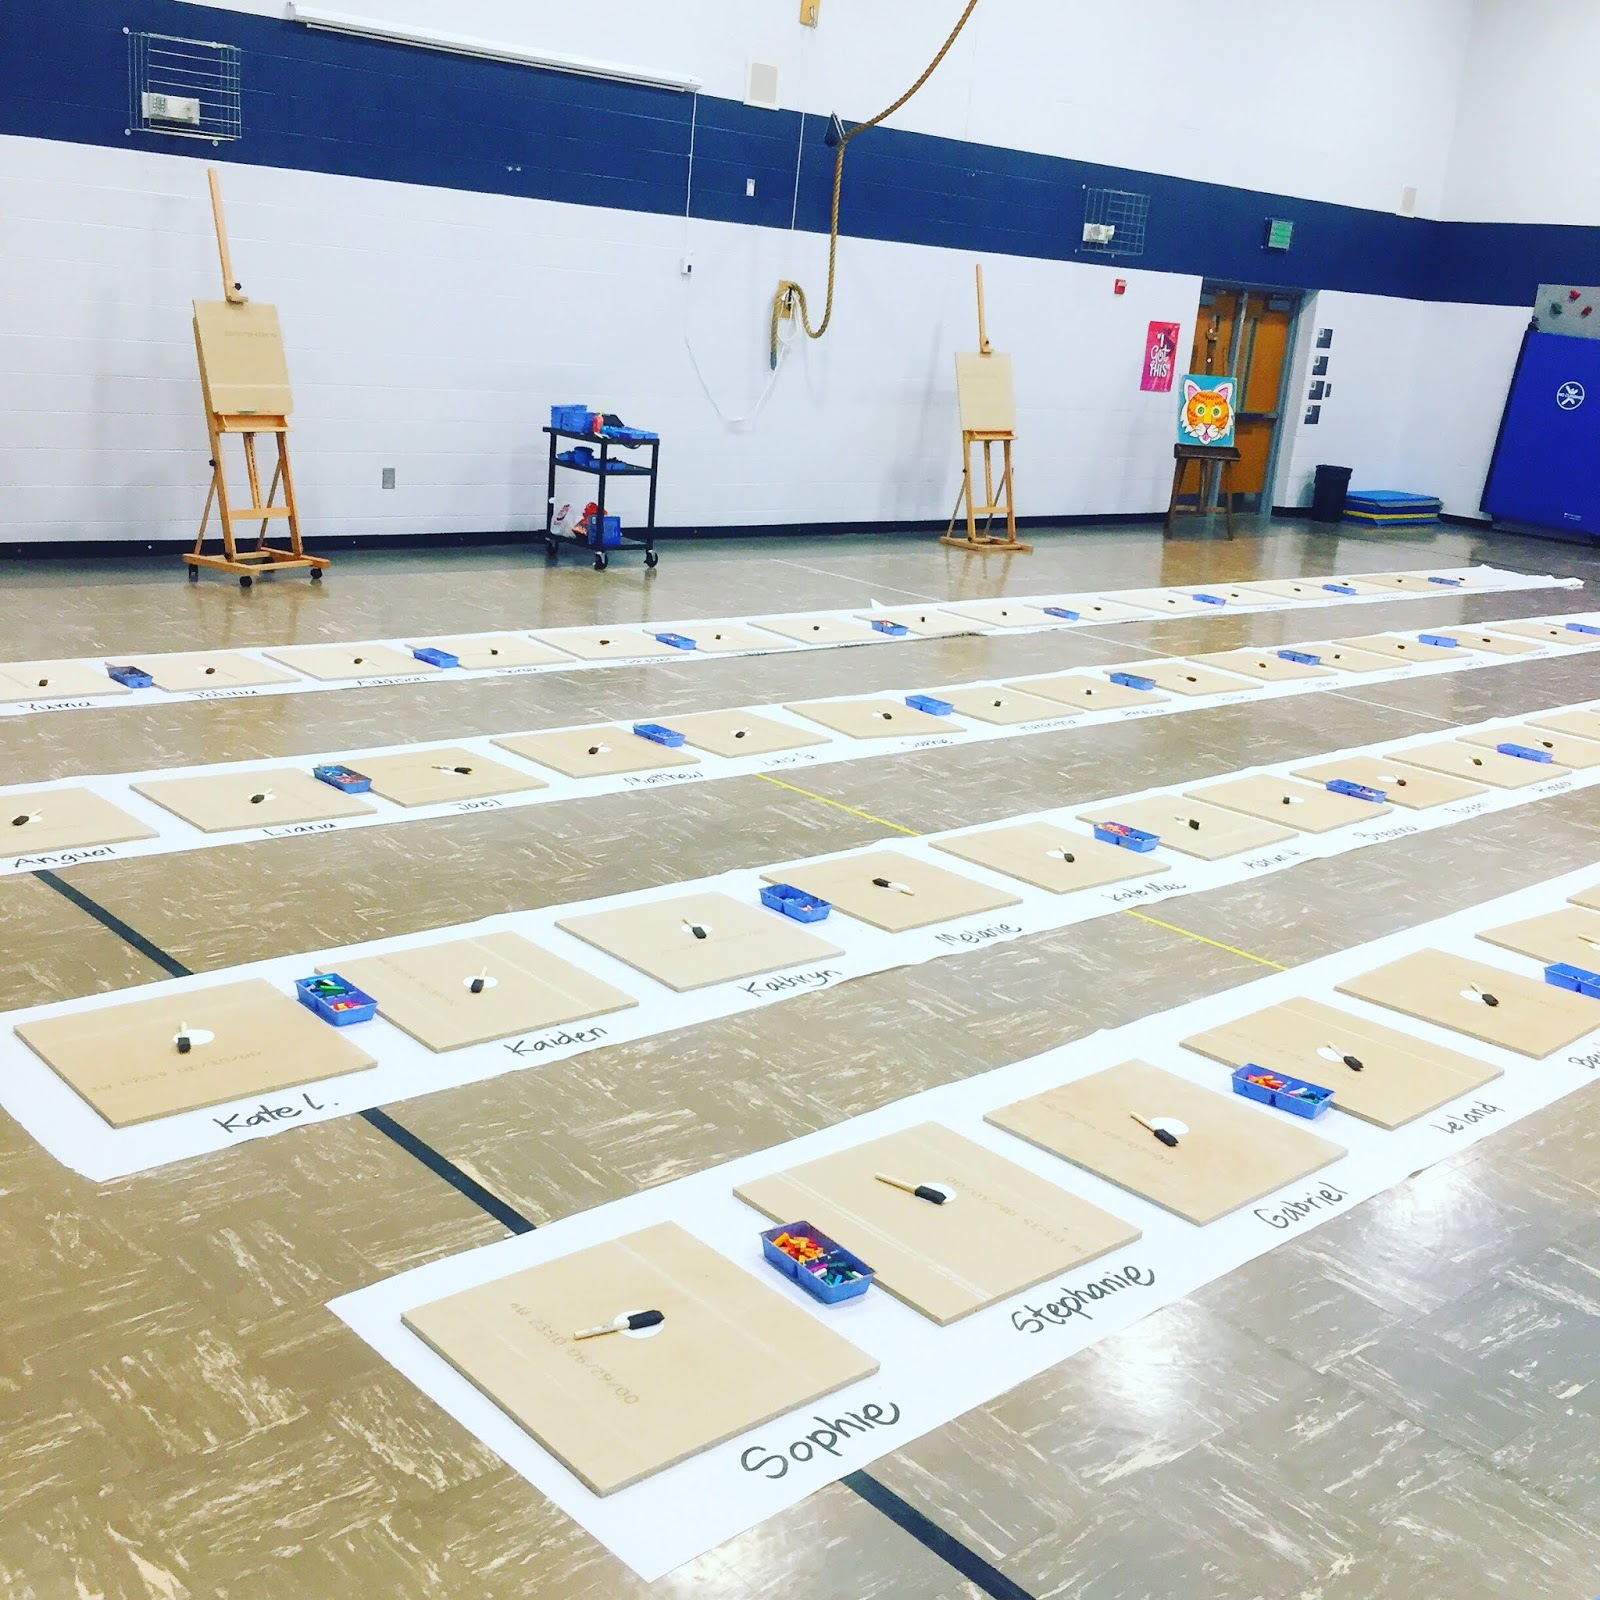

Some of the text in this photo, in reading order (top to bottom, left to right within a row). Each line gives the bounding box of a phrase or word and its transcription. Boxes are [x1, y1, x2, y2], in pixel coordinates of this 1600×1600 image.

[450, 798, 503, 811] Joel
[262, 823, 338, 836] Liana
[14, 846, 116, 868] Anguel
[934, 921, 1022, 946] Melanie
[738, 968, 843, 998] Kathryn
[503, 1025, 608, 1056] Kaiden
[212, 1104, 303, 1133] Kate
[1429, 1100, 1506, 1134] Leland
[1254, 1181, 1349, 1229] Gabriel
[1011, 1264, 1155, 1334] Stephanie
[740, 1401, 901, 1479] Sophie
